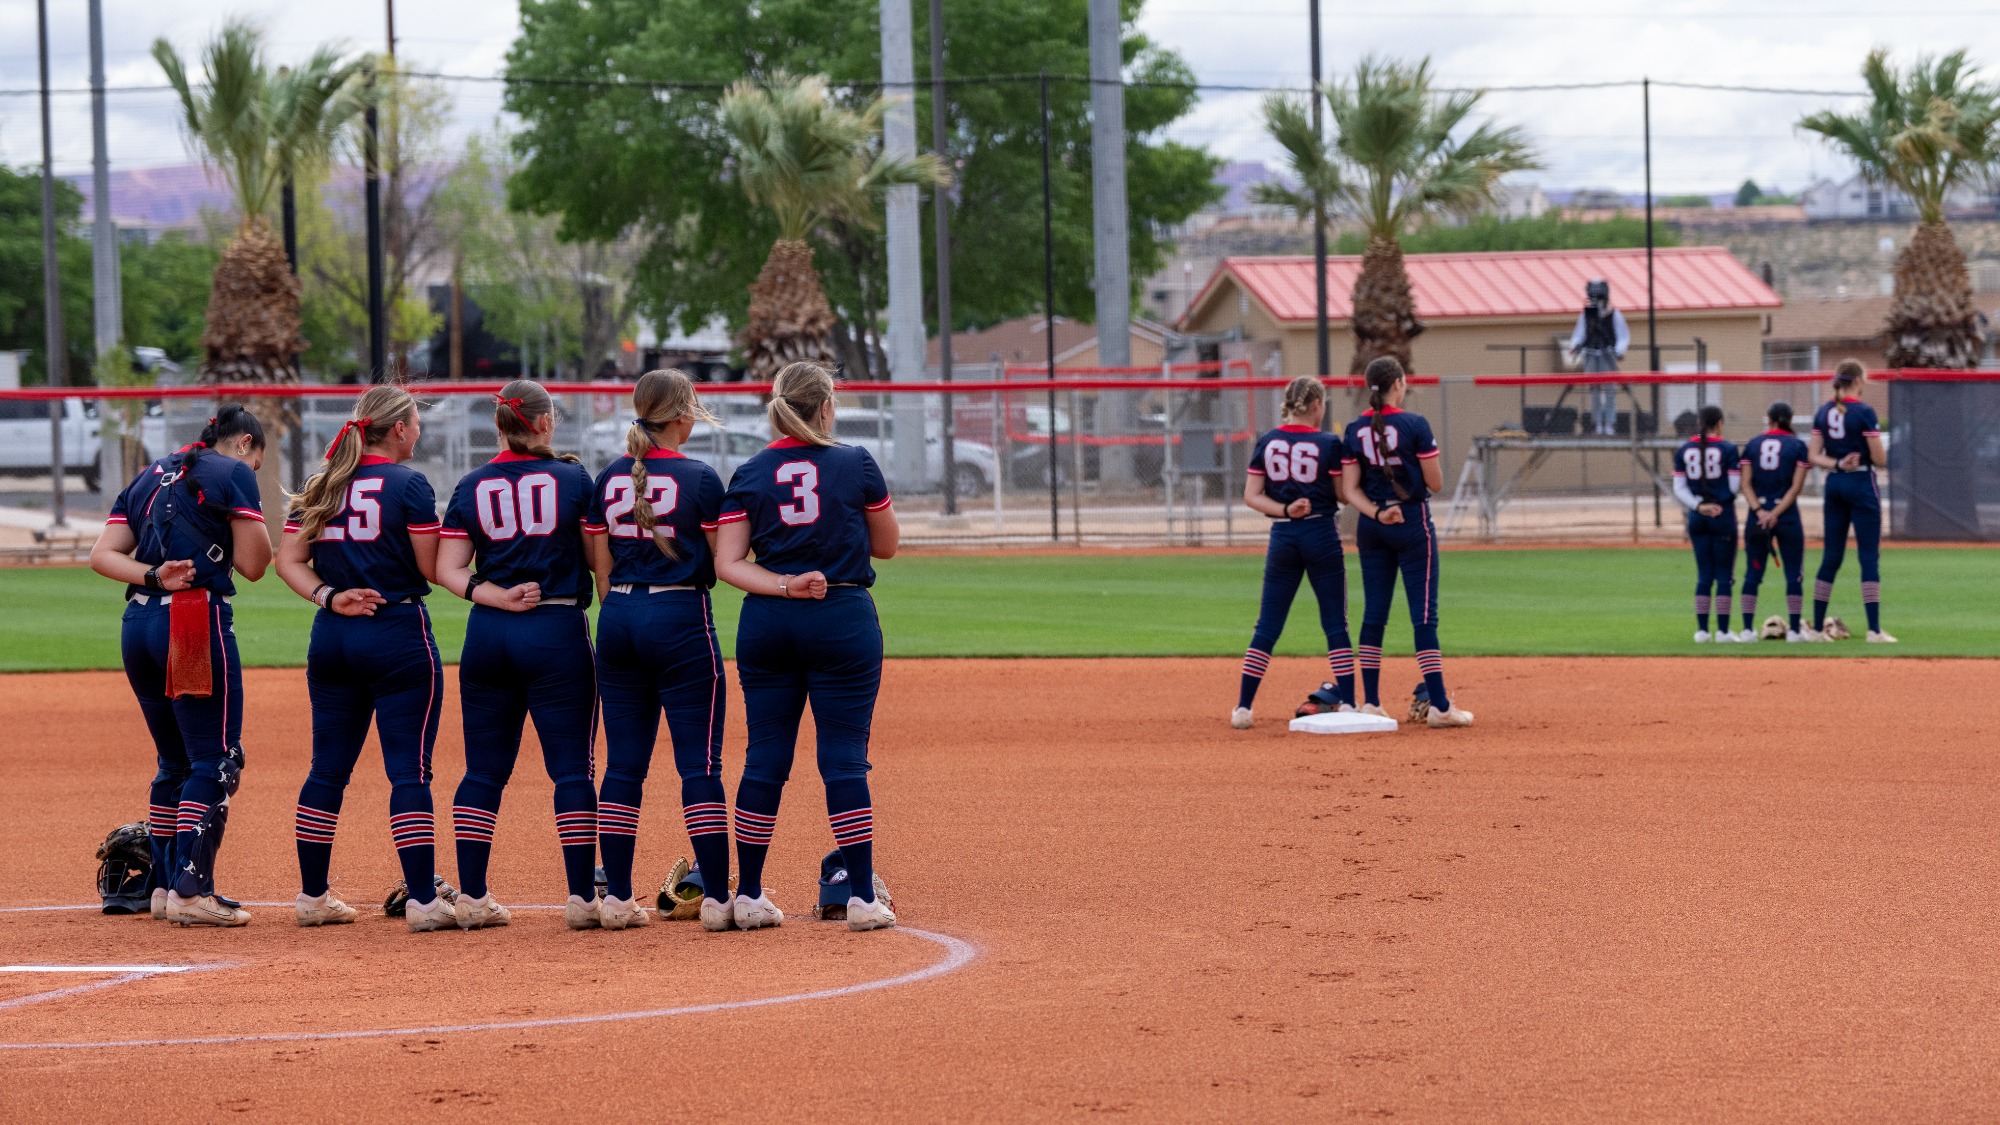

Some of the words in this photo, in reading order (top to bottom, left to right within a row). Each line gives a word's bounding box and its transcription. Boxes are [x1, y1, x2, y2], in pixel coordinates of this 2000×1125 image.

[1827, 407, 1847, 440] 9
[1264, 439, 1320, 484] 66
[1357, 425, 1403, 466] 12
[1683, 447, 1722, 480] 88
[1759, 438, 1782, 471] 8
[475, 472, 558, 541] 00
[604, 474, 679, 539] 22
[774, 460, 821, 526] 3
